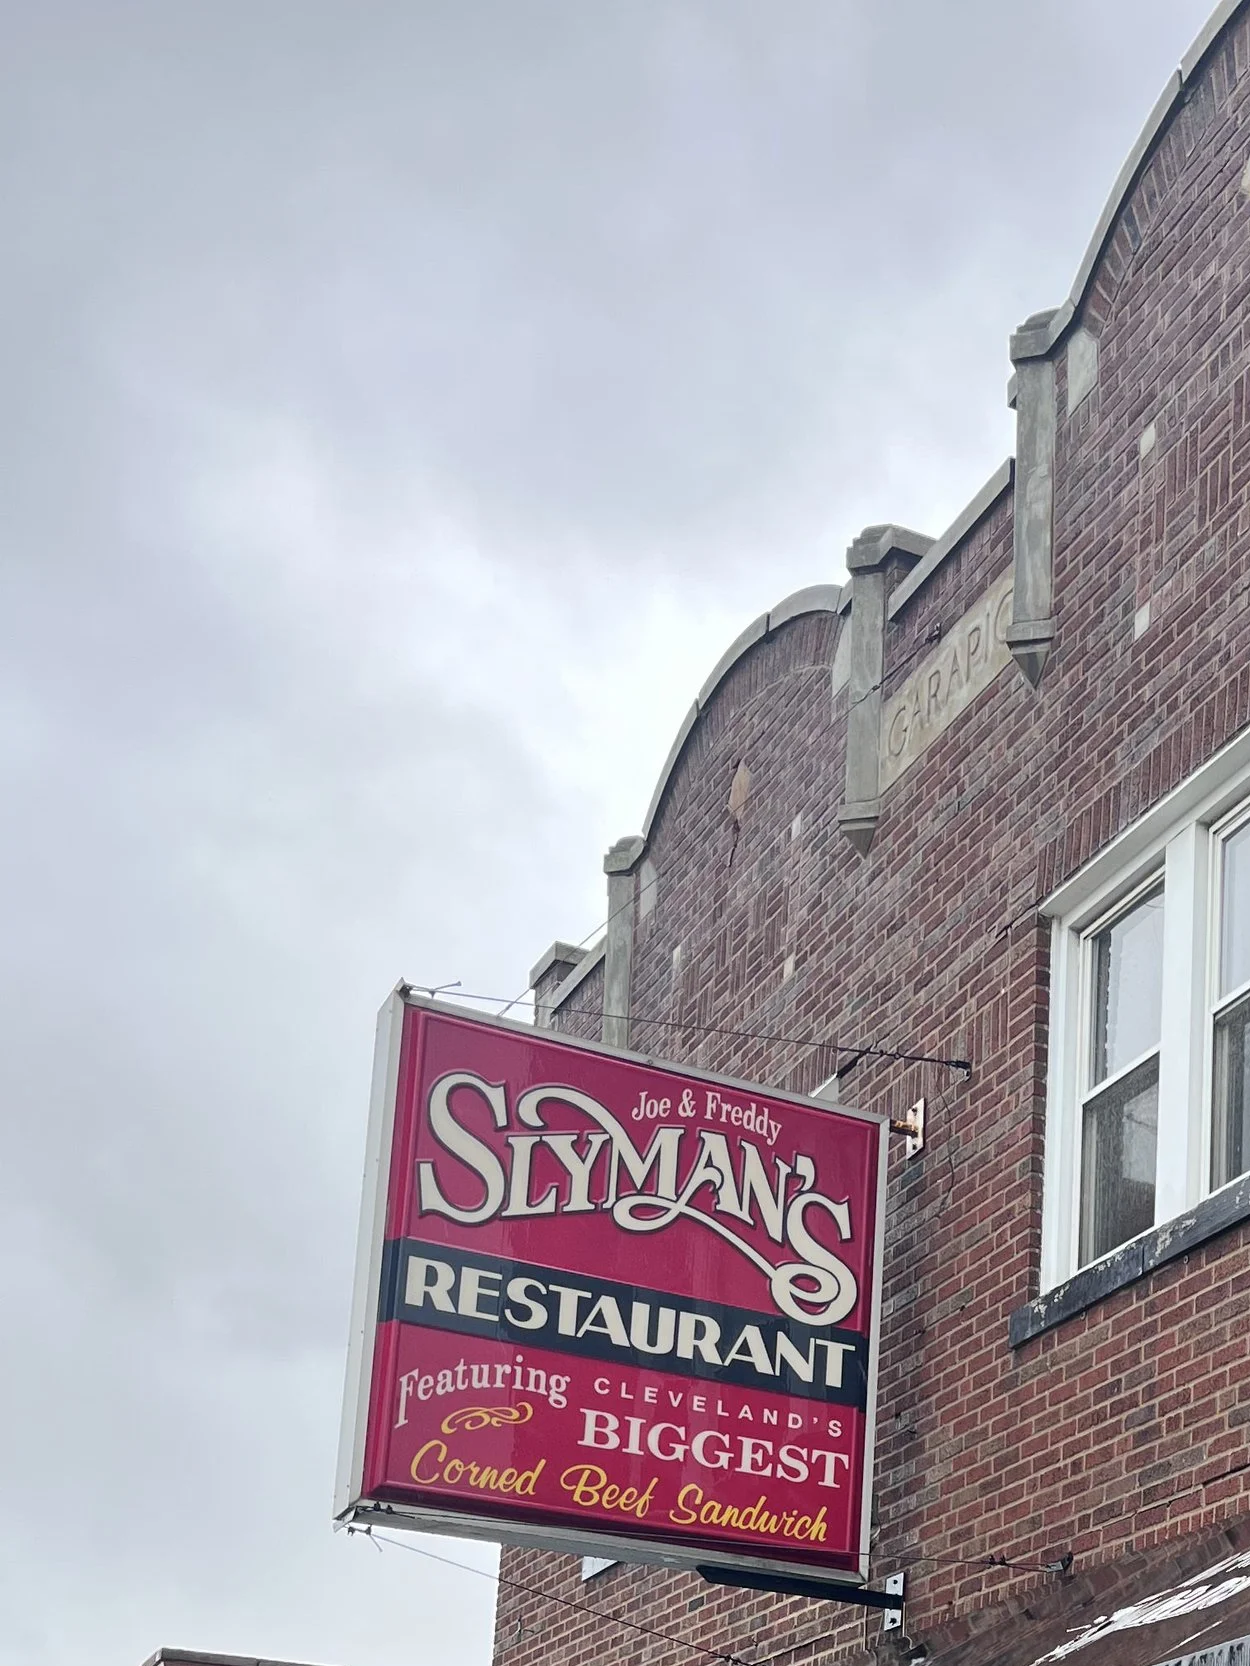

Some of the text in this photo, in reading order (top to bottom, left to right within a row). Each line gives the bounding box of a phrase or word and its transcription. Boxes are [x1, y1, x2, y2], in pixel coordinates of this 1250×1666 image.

[631, 1090, 783, 1146] Joe & Freddy
[418, 1071, 858, 1327] SLYMAN'S
[404, 1254, 856, 1389] RESTAURANT
[394, 1354, 844, 1439] Featuring CLEVELAND'S
[410, 1440, 829, 1544] Corned Beef Sandwich
[577, 1407, 850, 1490] BIGGEST
